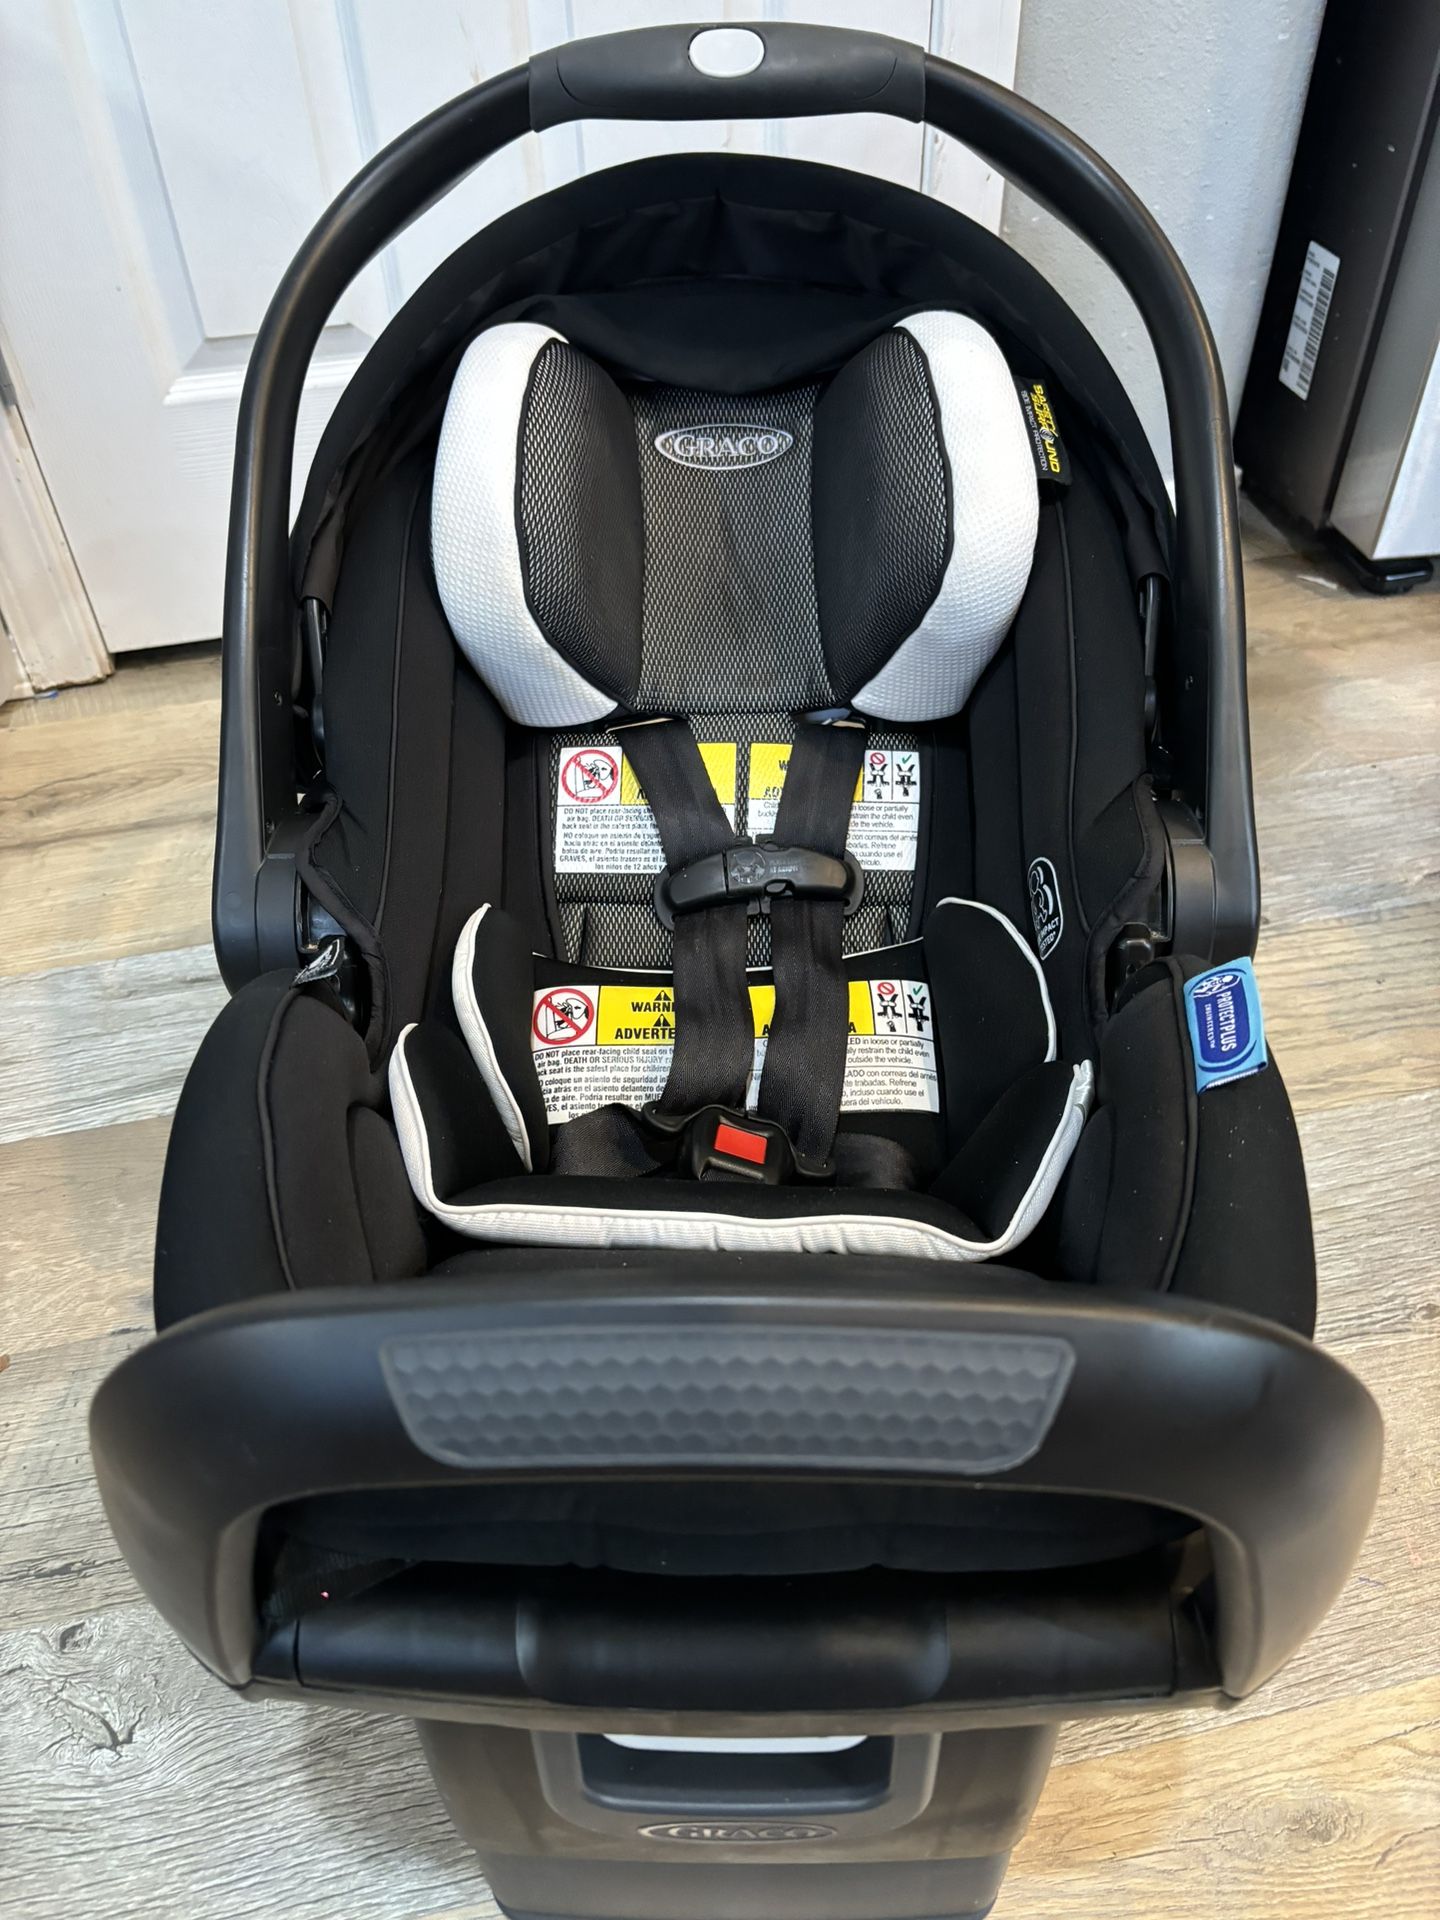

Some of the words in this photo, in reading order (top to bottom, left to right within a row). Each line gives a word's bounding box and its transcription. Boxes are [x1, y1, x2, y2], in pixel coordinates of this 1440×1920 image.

[1026, 404, 1038, 428] IMPACT
[1033, 429, 1048, 471] PROTECTION
[673, 434, 778, 457] GRACO
[884, 805, 908, 814] partially
[1040, 916, 1060, 938] MPACT
[631, 1002, 674, 1012] WARNI
[1216, 990, 1238, 1052] PROTECTPLUS
[614, 1028, 676, 1040] ADVERTE
[900, 1038, 924, 1050] partially
[535, 1052, 544, 1060] DO
[546, 1050, 560, 1058] NOT
[562, 1049, 580, 1058] place
[582, 1048, 621, 1056] rear-facing
[898, 1047, 914, 1056] child
[564, 1056, 588, 1064] DEATH
[602, 1056, 634, 1064] SERIOUS
[848, 1056, 874, 1064] outside
[888, 1056, 914, 1064] vehicle.
[549, 1066, 564, 1074] seat
[610, 1065, 630, 1074] place
[908, 1070, 919, 1078] del
[545, 1078, 572, 1086] coloque
[584, 1076, 610, 1084] asiento
[612, 1076, 621, 1084] de
[622, 1075, 658, 1084] seguridad
[854, 1078, 887, 1086] trabadas.
[889, 1078, 916, 1087] Refrene
[554, 1086, 572, 1094] atrás
[584, 1084, 591, 1092] el
[592, 1084, 619, 1092] asiento
[620, 1084, 654, 1092] delantero
[918, 1089, 924, 1097] el
[561, 1102, 568, 1110] el
[570, 1102, 596, 1110] asiento
[858, 1098, 870, 1106] del
[871, 1098, 903, 1106] vehículo.
[668, 1826, 817, 1838] GRACO
